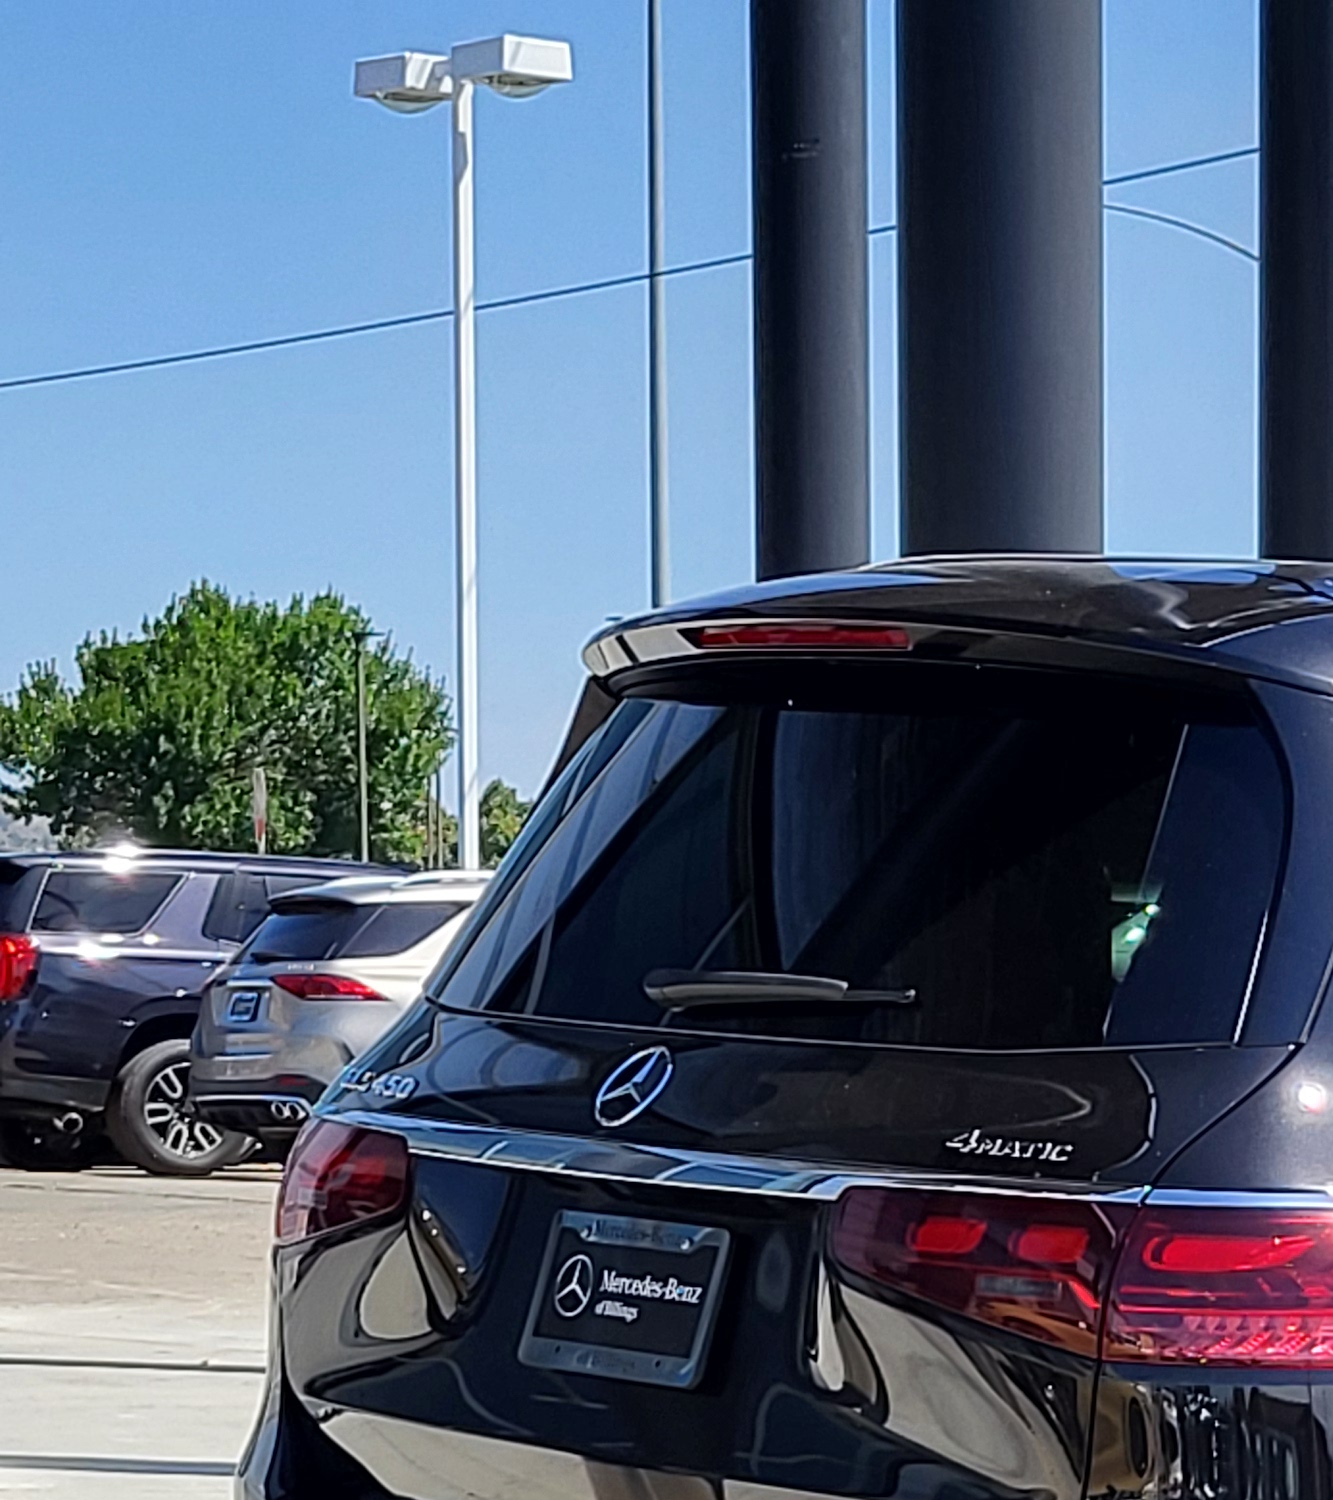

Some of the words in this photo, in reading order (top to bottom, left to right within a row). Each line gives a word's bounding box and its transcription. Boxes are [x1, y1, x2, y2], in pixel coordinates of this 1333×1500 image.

[371, 1074, 417, 1099] 450
[945, 1128, 1075, 1162] 4MATIC
[599, 1269, 703, 1304] Mercedes-Benz
